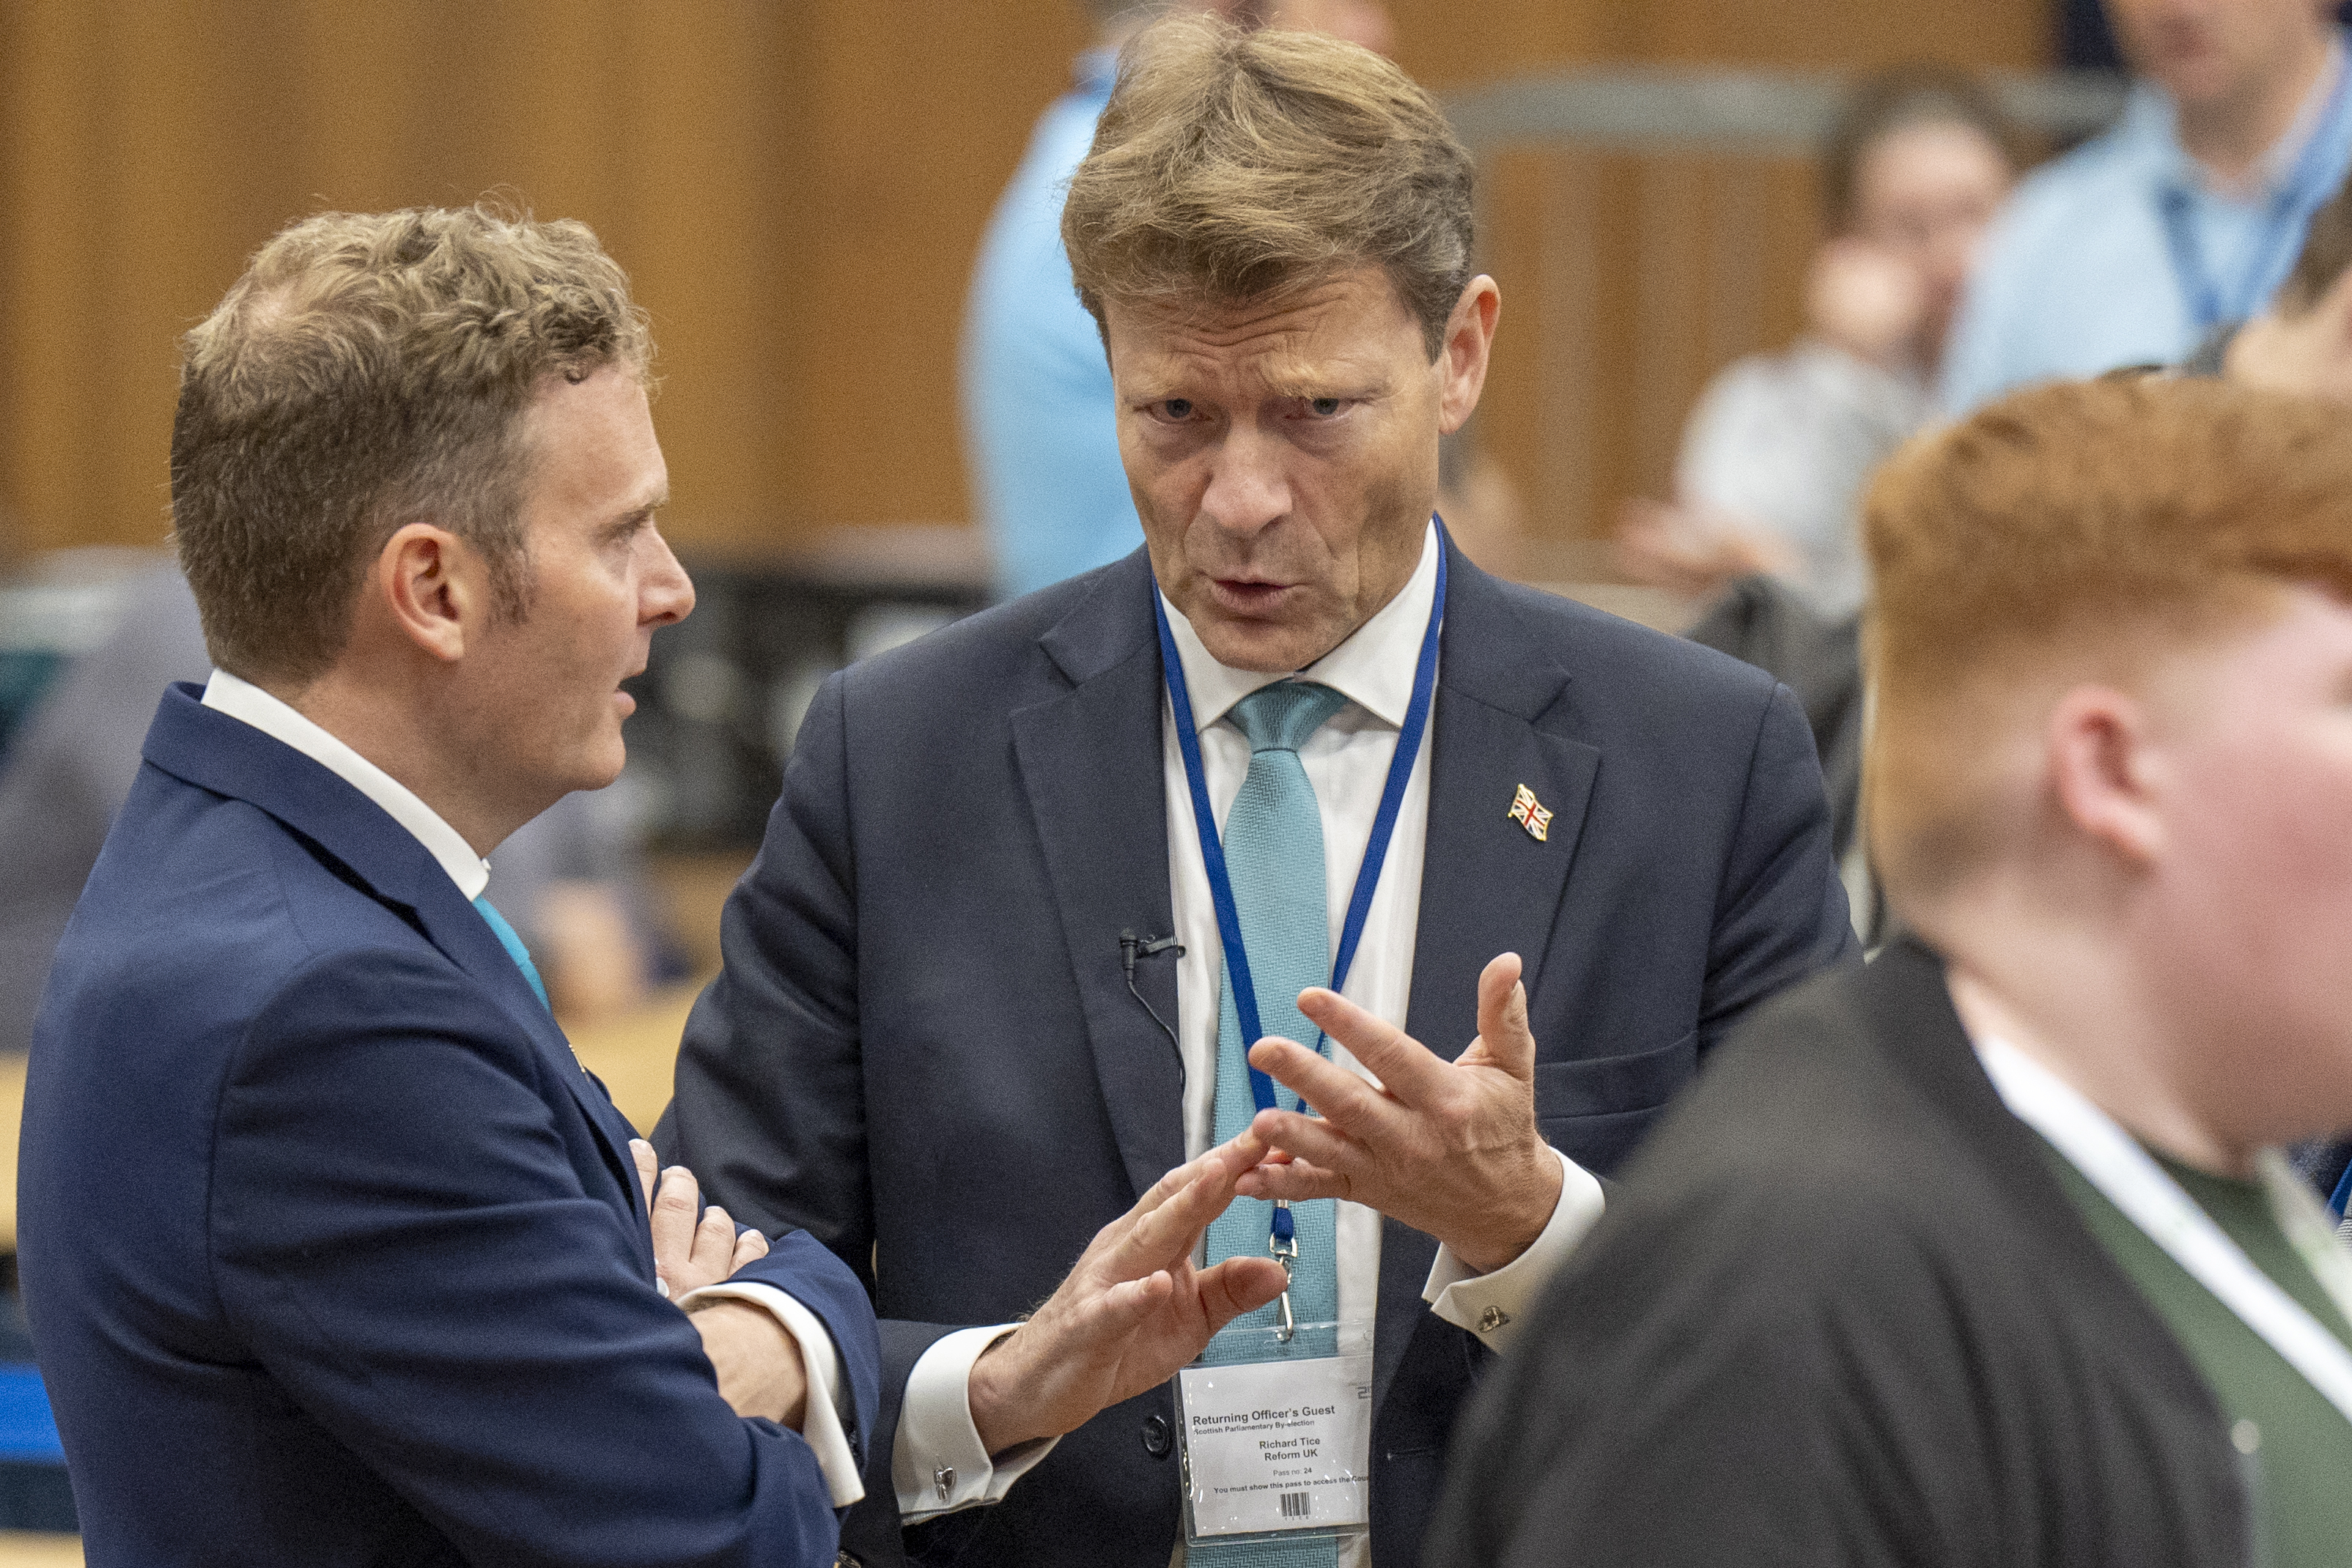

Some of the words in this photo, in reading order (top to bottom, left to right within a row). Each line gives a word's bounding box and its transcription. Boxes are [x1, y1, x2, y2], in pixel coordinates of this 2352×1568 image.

[1193, 1413, 1248, 1425] Returning
[1252, 1408, 1299, 1420] Officer's
[1302, 1405, 1335, 1416] Guest
[1194, 1427, 1223, 1435] Scottish
[1225, 1423, 1273, 1433] Parliamentary
[1275, 1419, 1315, 1430] By-election
[1259, 1439, 1297, 1449] Richard
[1300, 1437, 1320, 1446] Tice
[1264, 1451, 1300, 1461] Reform
[1303, 1449, 1319, 1458] UK
[1214, 1487, 1228, 1495] You
[1230, 1484, 1247, 1493] must
[1249, 1483, 1269, 1492] show
[1269, 1481, 1283, 1490] this
[1285, 1481, 1302, 1490] pass
[1313, 1478, 1337, 1486] access
[1339, 1476, 1350, 1484] the
[1352, 1474, 1369, 1482] Cou
